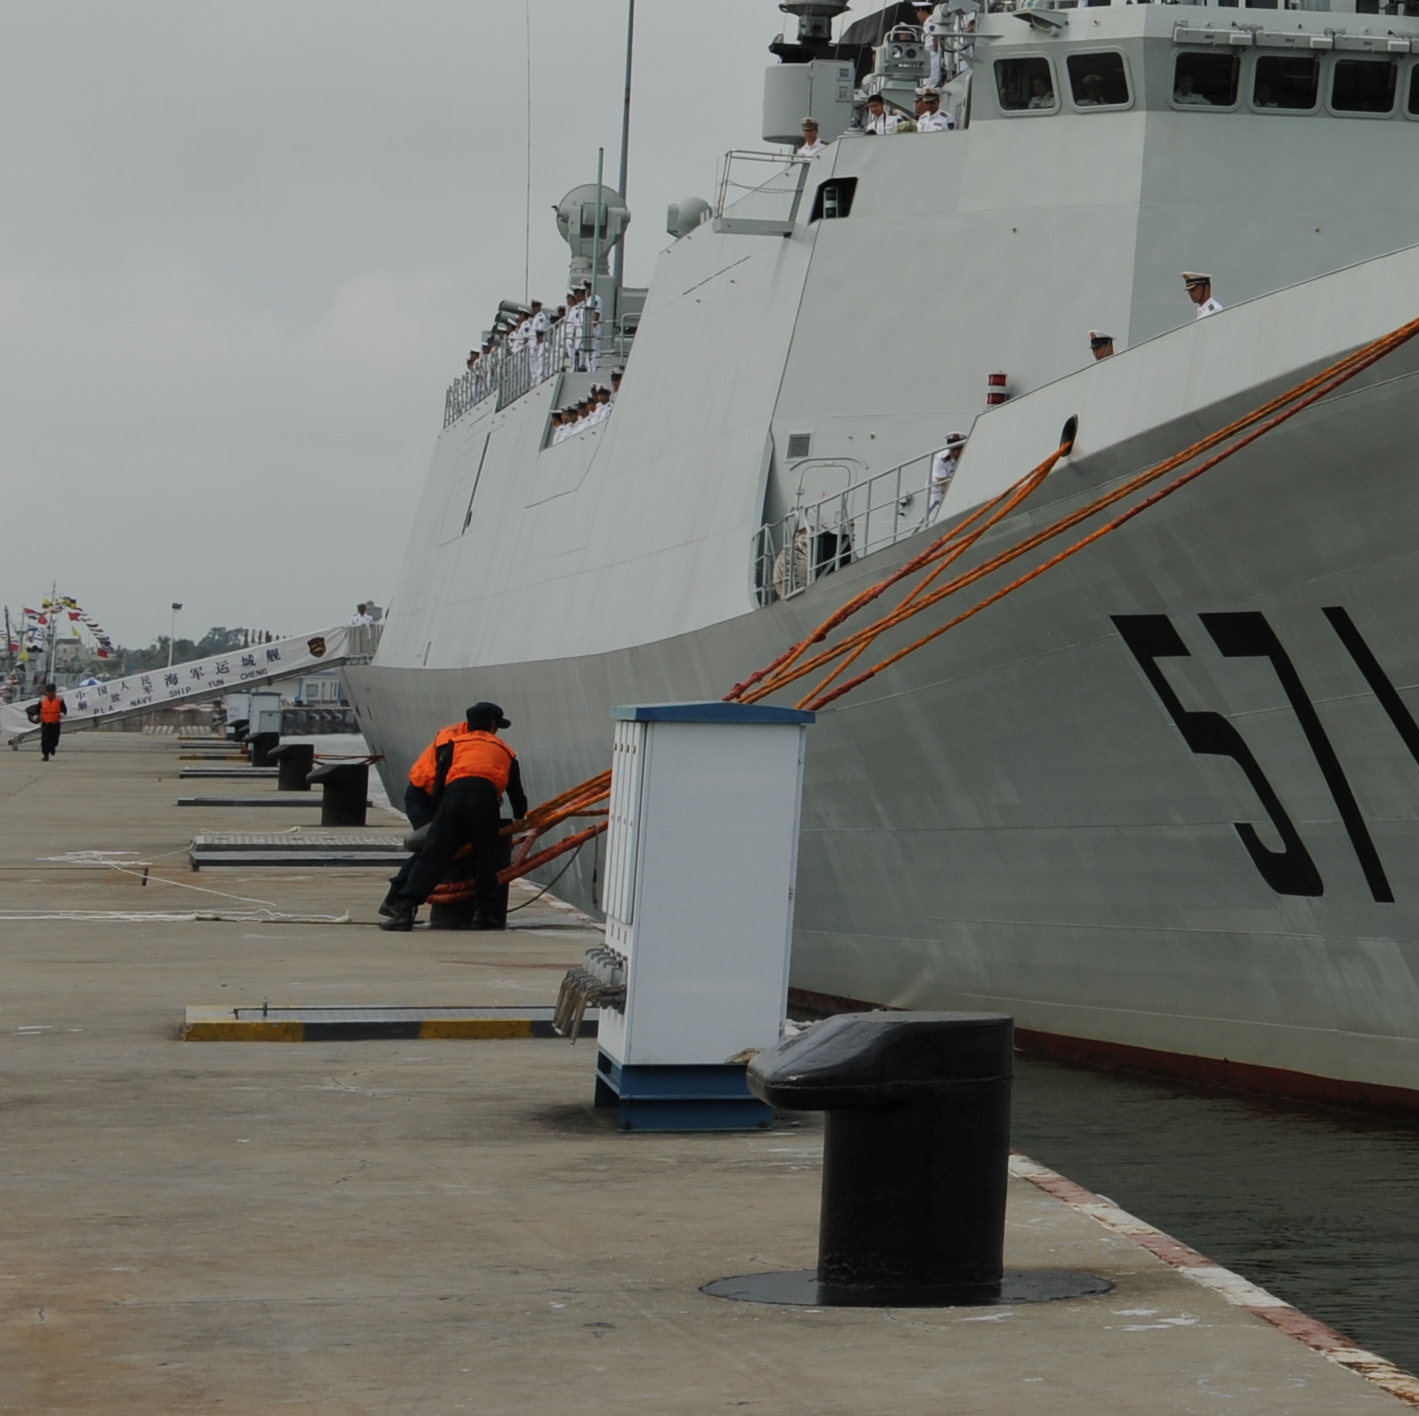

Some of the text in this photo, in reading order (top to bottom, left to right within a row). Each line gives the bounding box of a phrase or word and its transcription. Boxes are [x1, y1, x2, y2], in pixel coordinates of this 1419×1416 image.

[130, 696, 153, 707] NAVY
[169, 686, 191, 698] SHIP
[208, 678, 225, 689] YUN
[240, 667, 268, 681] CHENG
